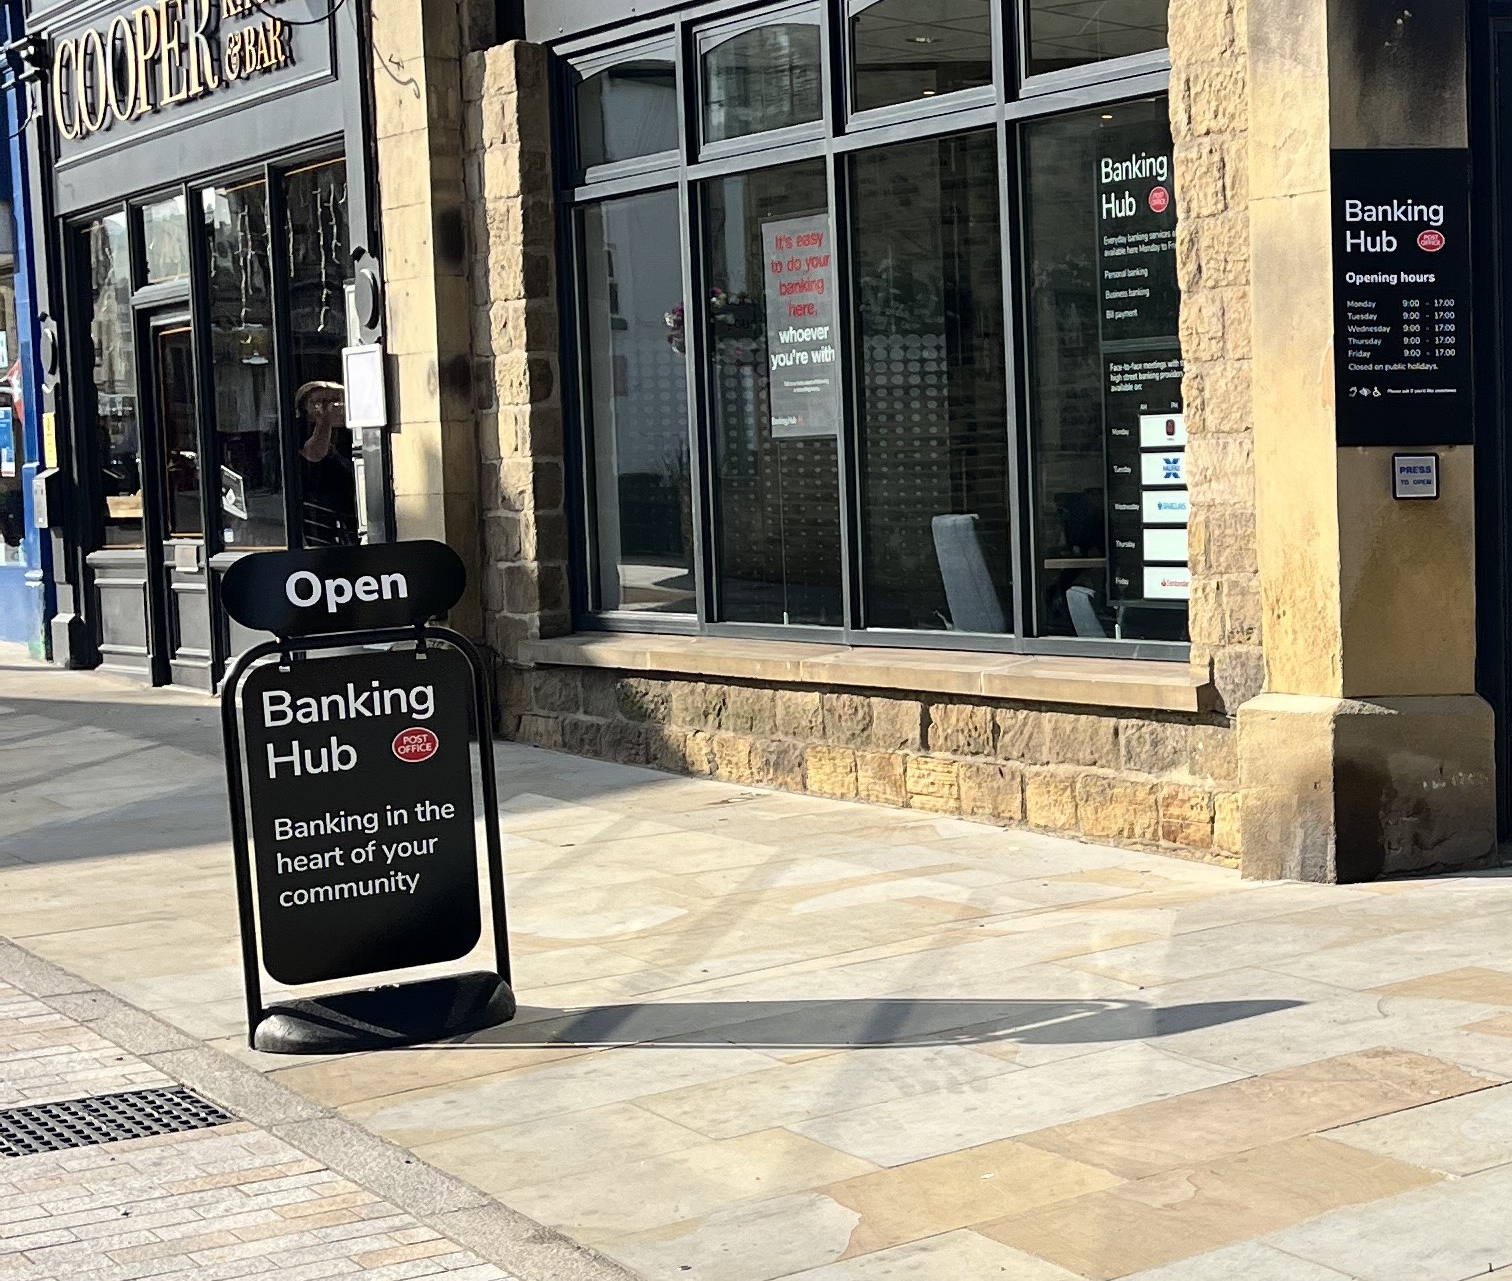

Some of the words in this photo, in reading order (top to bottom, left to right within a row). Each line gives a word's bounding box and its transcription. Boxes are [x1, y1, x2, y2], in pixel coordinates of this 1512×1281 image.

[244, 19, 286, 74] BAR
[1101, 152, 1168, 184] Banking
[1101, 190, 1137, 219] Hub
[1345, 198, 1444, 227] Banking
[775, 233, 793, 251] It's
[796, 230, 824, 248] easy
[1345, 229, 1398, 253] Hub
[771, 259, 785, 274] to
[787, 256, 802, 271] do
[805, 254, 831, 273] your
[779, 277, 825, 296] banking
[1345, 271, 1398, 286] Opening
[1400, 271, 1436, 283] hours
[1347, 300, 1377, 309] Monday
[1347, 312, 1378, 321] Tuesday
[779, 325, 830, 345] whoever
[1347, 325, 1391, 333] Wednesday
[1347, 337, 1382, 346] Thursday
[771, 350, 809, 371] you're
[811, 345, 836, 364] with
[1347, 349, 1371, 358] Friday
[1348, 362, 1373, 371] Closed
[1374, 363, 1384, 371] on
[1384, 362, 1406, 372] public
[1400, 465, 1432, 475] PRESS
[285, 569, 408, 613] Open
[262, 680, 435, 728] Banking
[396, 741, 433, 756] OFFICE
[402, 733, 429, 747] POST
[266, 736, 358, 780] Hub
[273, 808, 379, 842] Banking
[385, 802, 410, 827] in
[413, 799, 455, 822] the
[276, 846, 344, 874] heart
[350, 840, 376, 865] of
[381, 835, 438, 866] your
[279, 870, 421, 908] community
